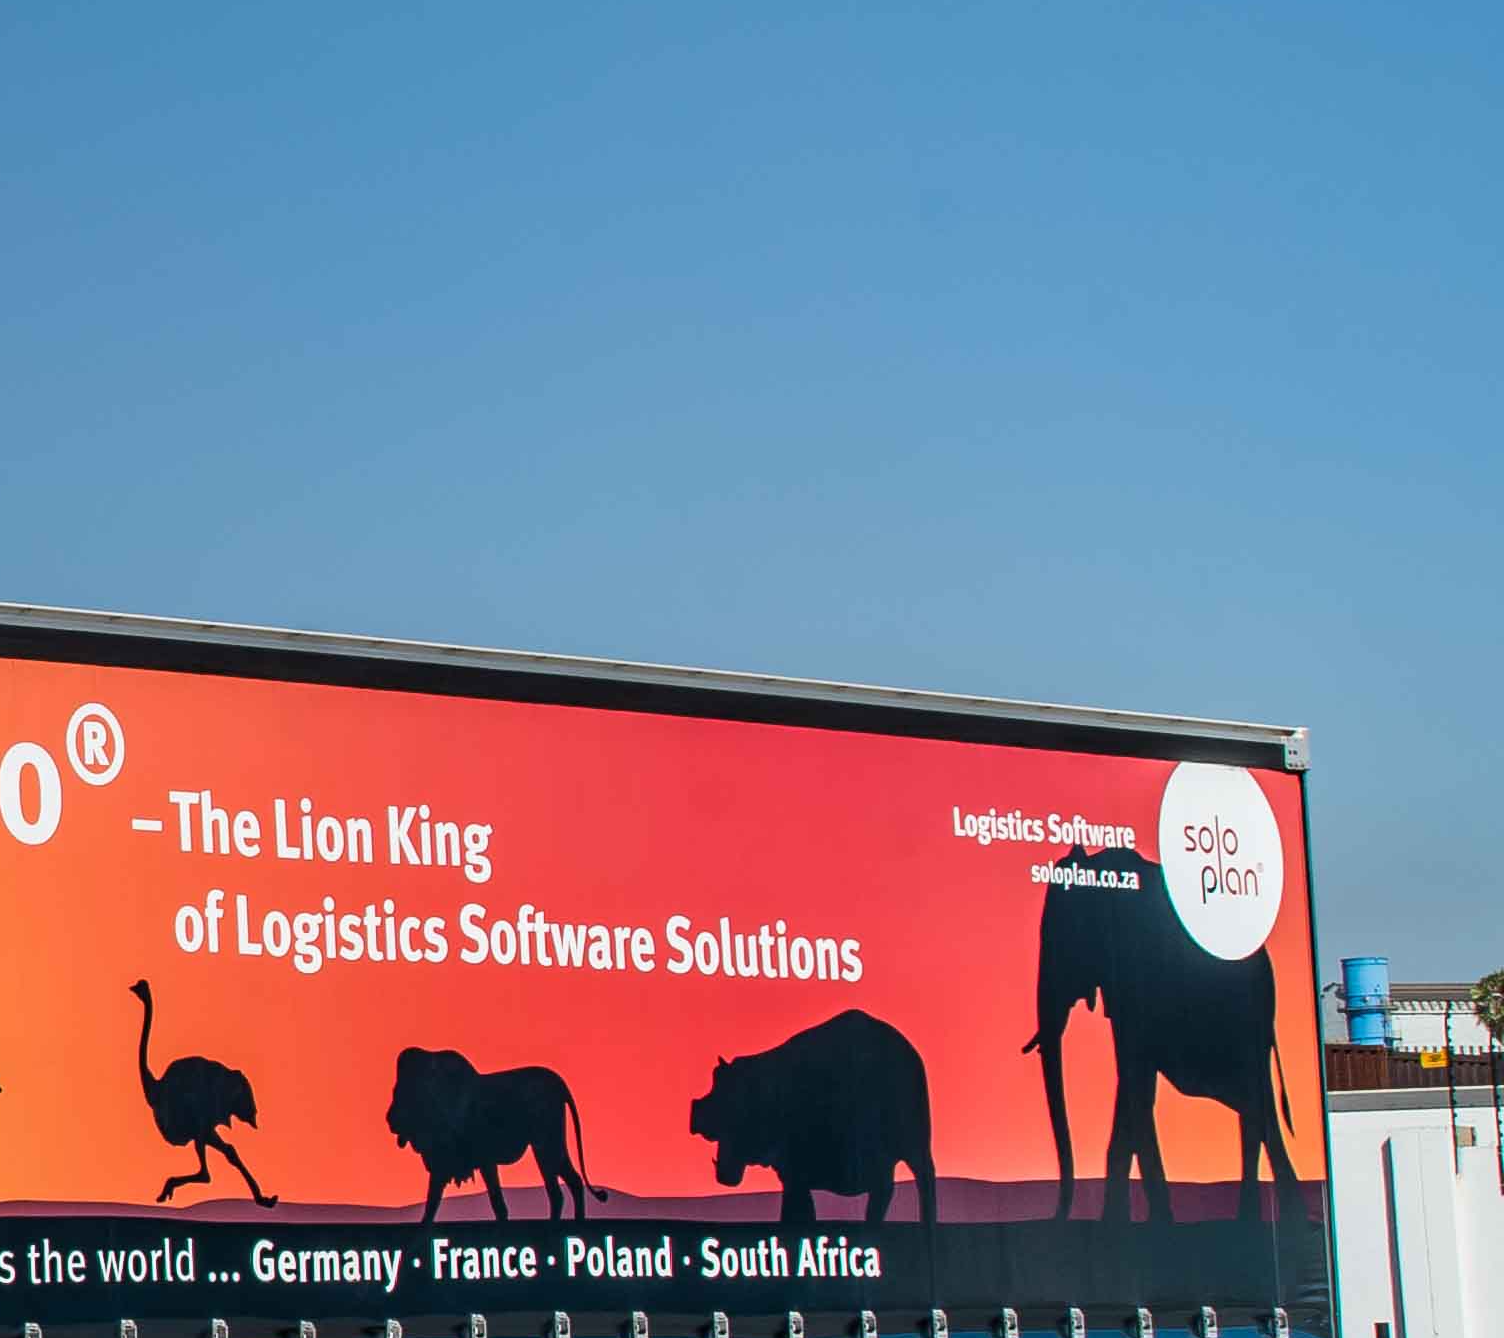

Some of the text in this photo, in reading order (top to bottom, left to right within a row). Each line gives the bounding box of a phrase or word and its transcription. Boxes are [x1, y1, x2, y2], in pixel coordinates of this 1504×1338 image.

[273, 797, 373, 863] Lion
[386, 804, 493, 884] King
[953, 806, 1136, 849] Logistics Software
[1184, 814, 1238, 856] solo
[1031, 861, 1139, 890] soloplan.co.za
[174, 888, 863, 983] of Logistics Software Solutions
[27, 1238, 86, 1285] the
[96, 1237, 195, 1283] world
[251, 1238, 403, 1293] Germany
[432, 1238, 538, 1280] France
[565, 1235, 674, 1278] Poland
[700, 1236, 789, 1278] South
[797, 1235, 882, 1279] Africa
